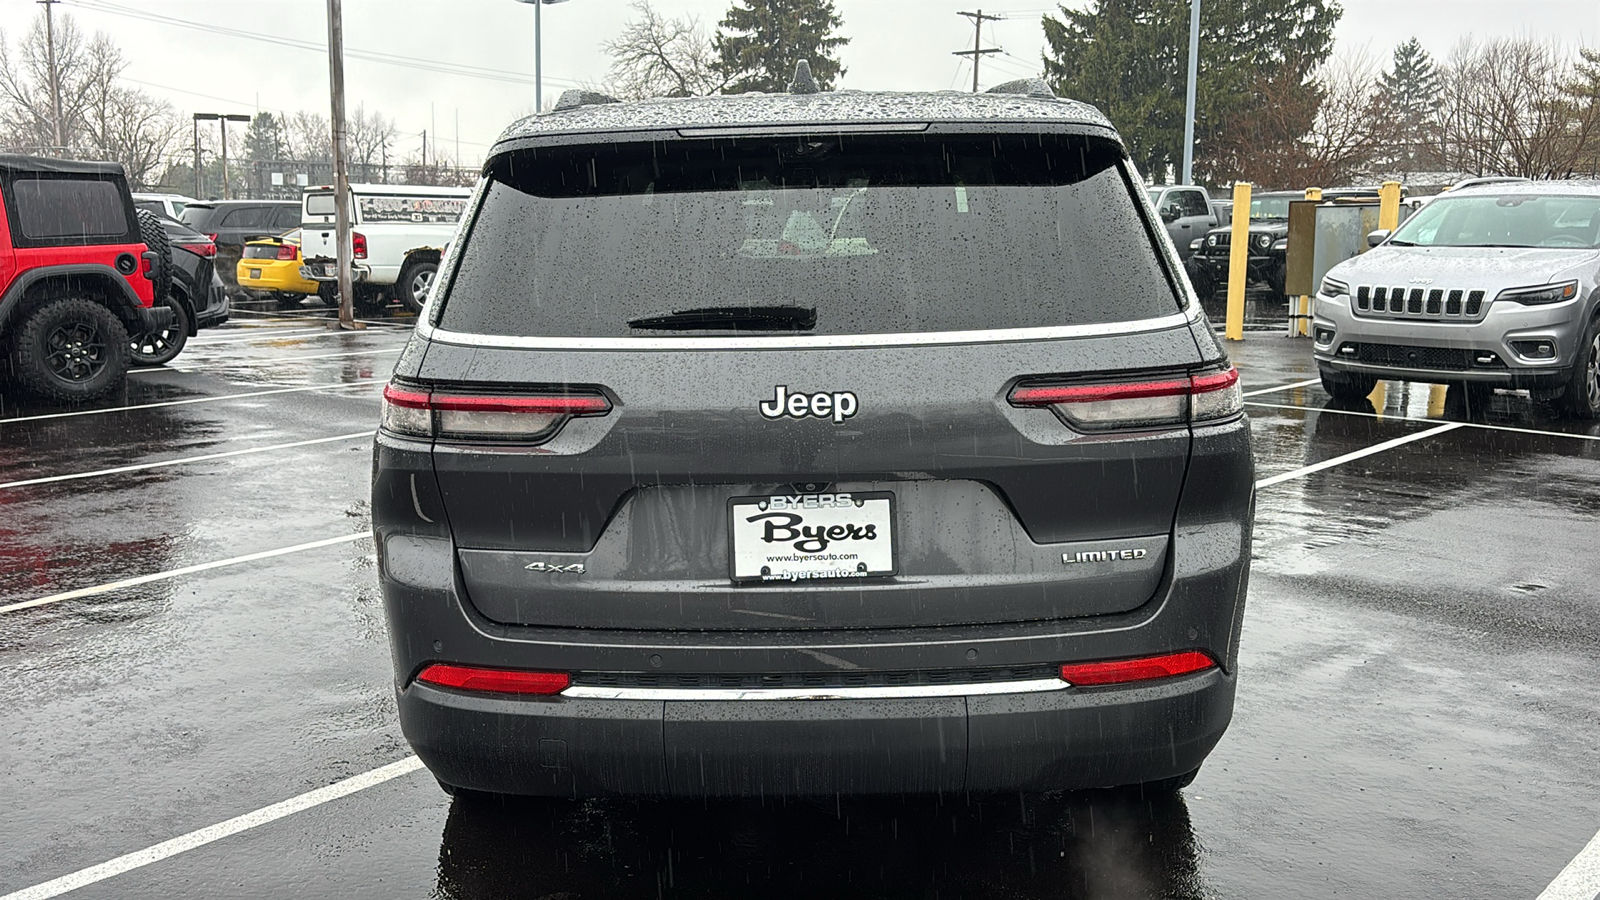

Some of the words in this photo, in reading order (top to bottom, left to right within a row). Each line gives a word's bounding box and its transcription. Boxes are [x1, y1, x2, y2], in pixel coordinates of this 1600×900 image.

[1409, 276, 1433, 285] Jeep
[760, 386, 857, 422] Jeep
[770, 494, 852, 510] BYERS
[746, 512, 877, 553] Byers
[766, 553, 858, 563] www.byersauto.com
[1062, 548, 1147, 563] LIMITED
[762, 567, 867, 582] www.byersauto.com
